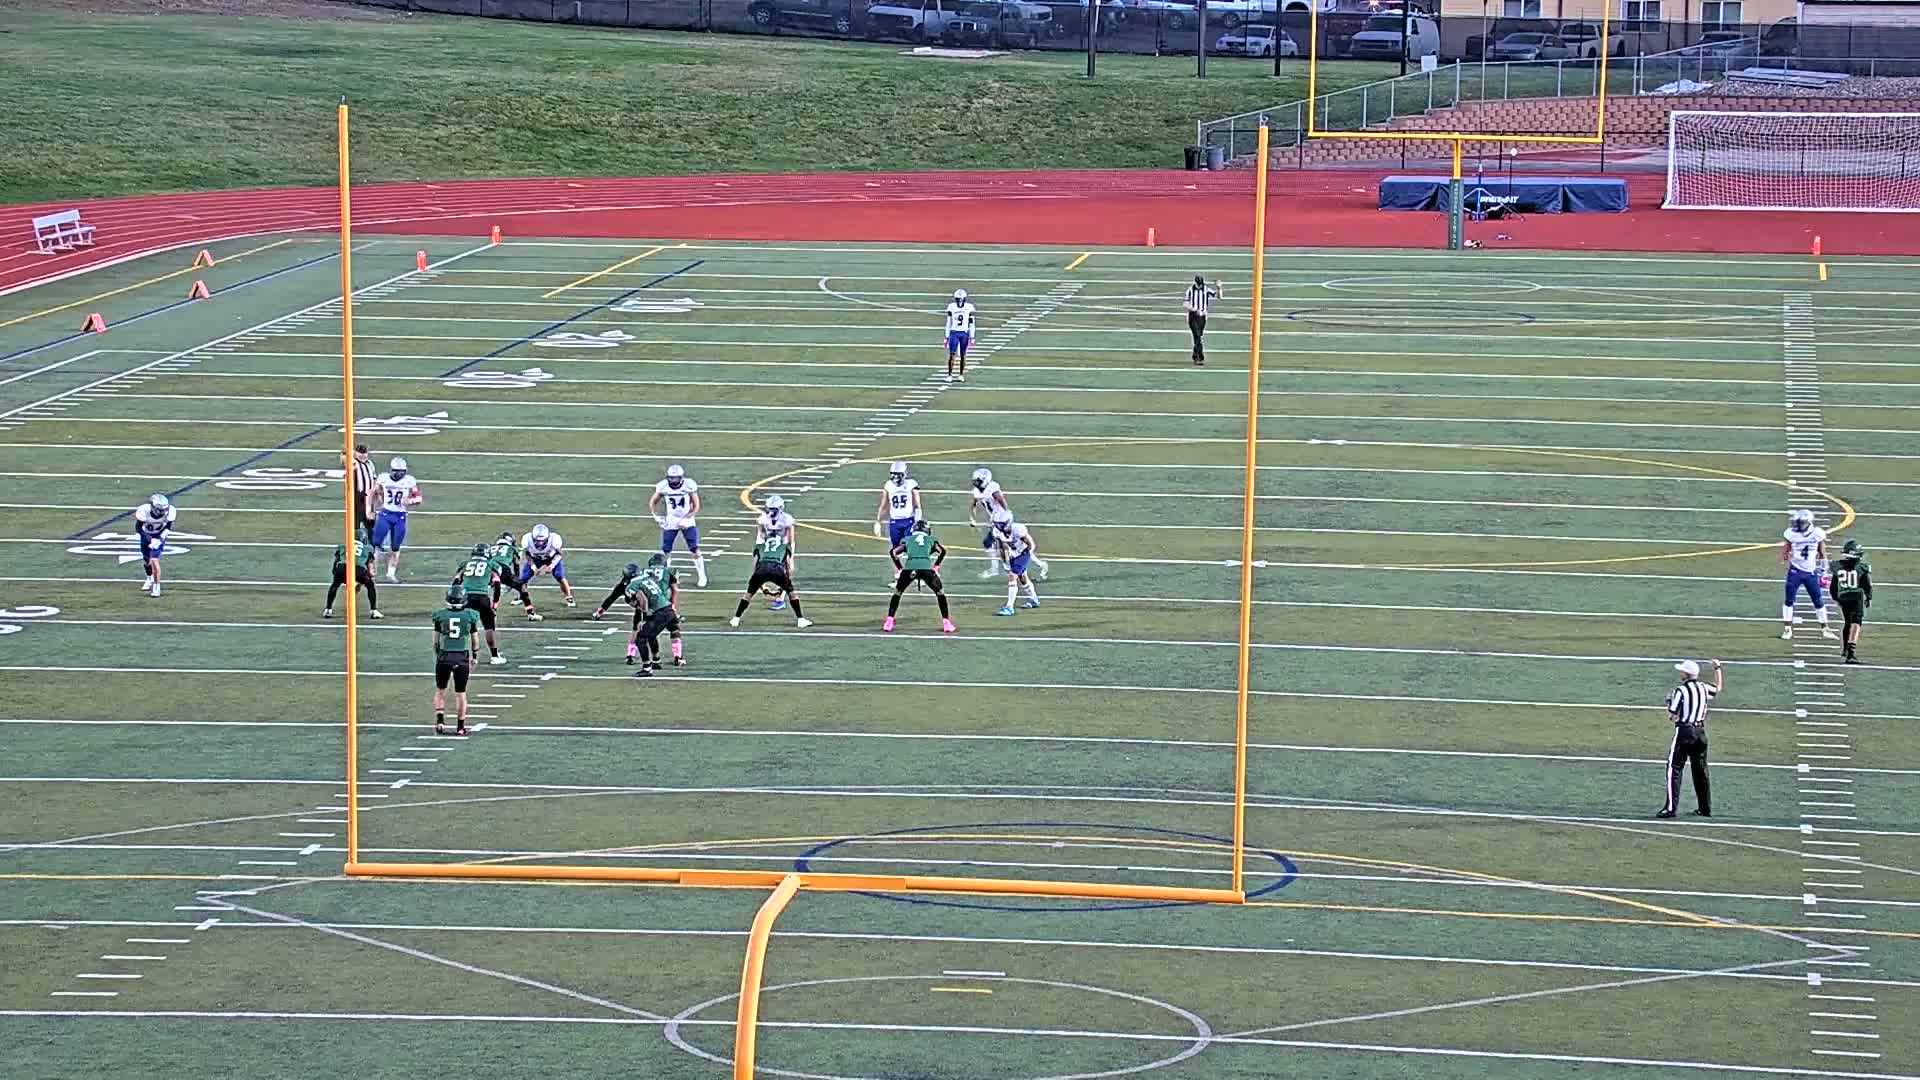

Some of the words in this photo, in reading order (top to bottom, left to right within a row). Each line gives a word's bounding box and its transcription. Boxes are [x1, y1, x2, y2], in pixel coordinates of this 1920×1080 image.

[957, 314, 964, 326] 9
[914, 534, 925, 546] 4
[1800, 544, 1810, 561] 4
[463, 560, 488, 577] 58
[1837, 569, 1858, 589] 20
[448, 617, 461, 639] 5
